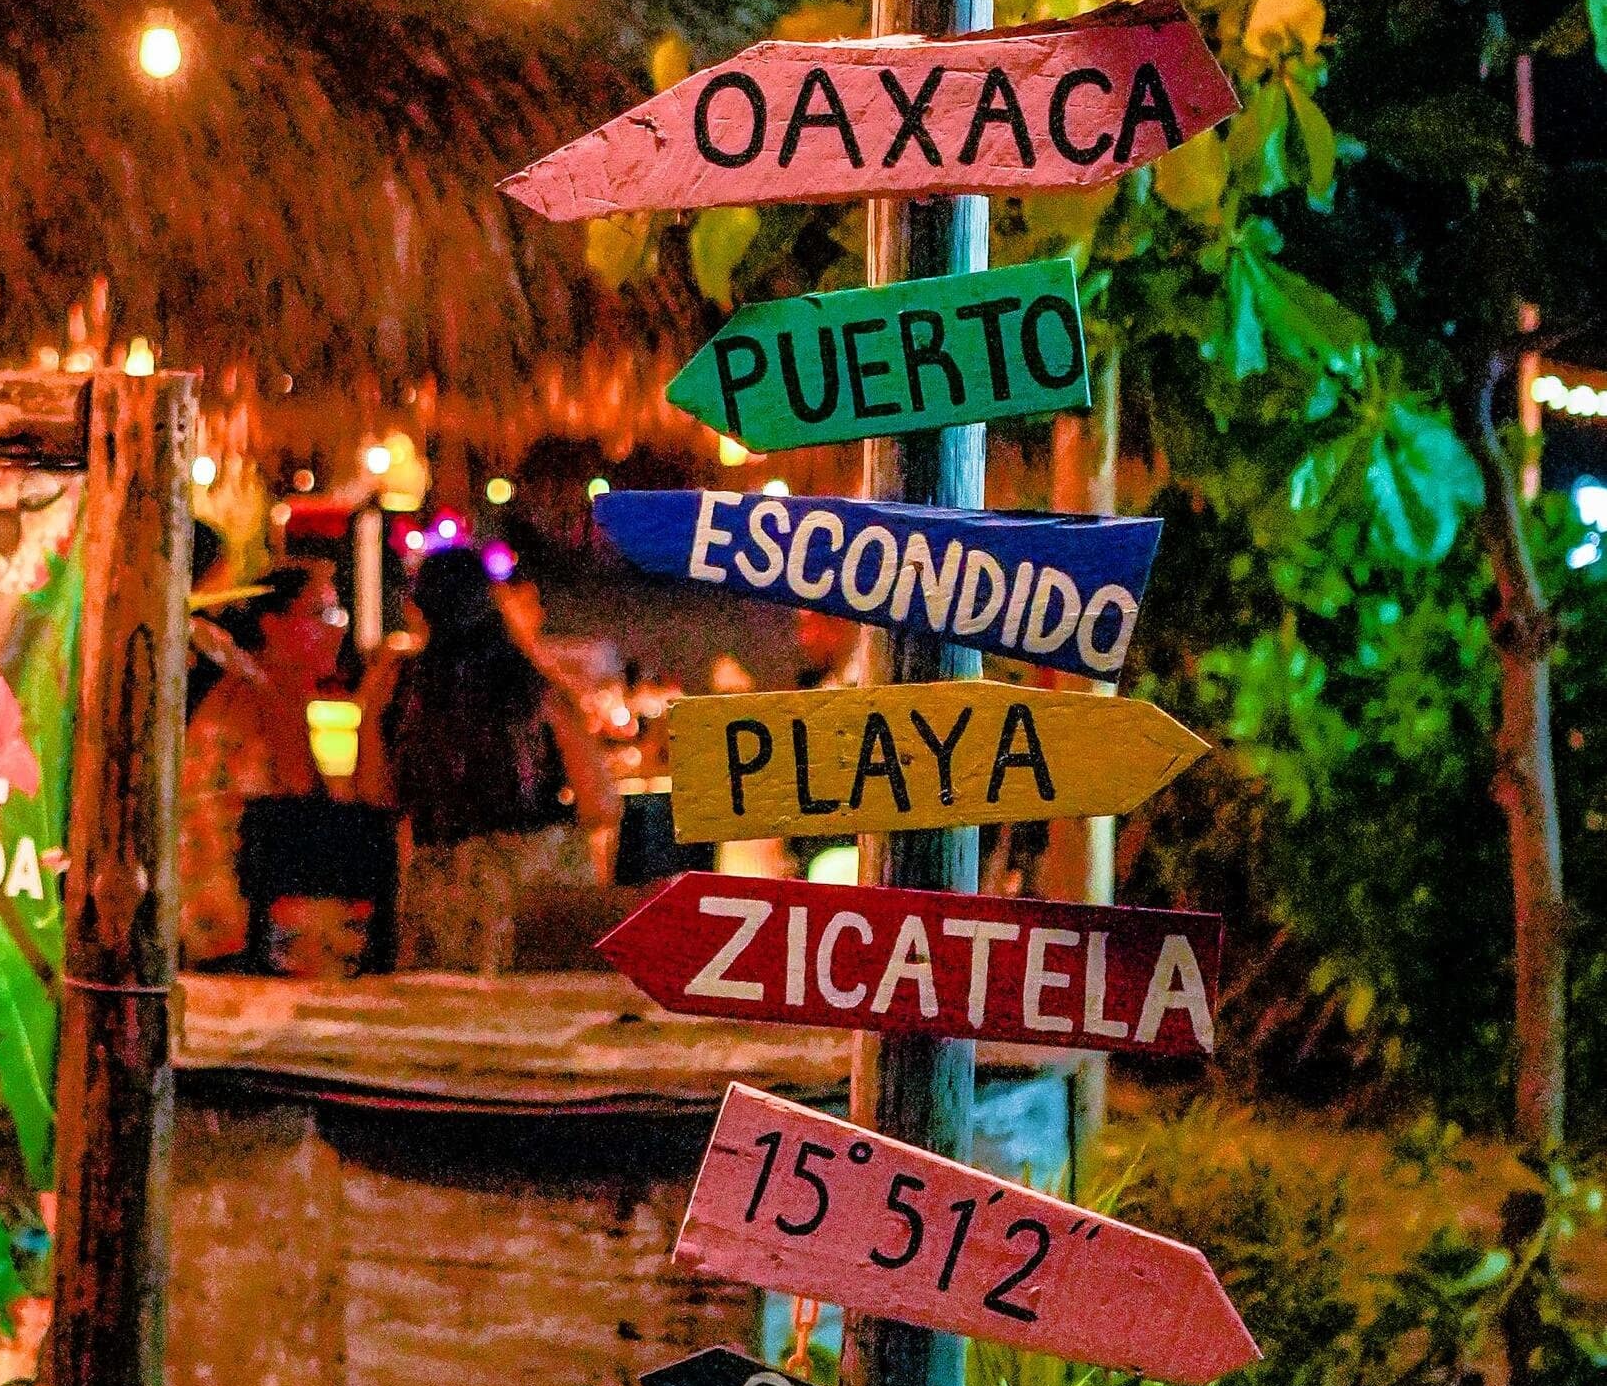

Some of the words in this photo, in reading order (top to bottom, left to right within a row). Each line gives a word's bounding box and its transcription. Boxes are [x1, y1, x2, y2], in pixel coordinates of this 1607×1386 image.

[692, 61, 1183, 169] OAXACA
[712, 293, 1084, 435] PUERTO
[688, 490, 1141, 672] ESCONDIDO
[725, 703, 1056, 816] PLAYA
[684, 896, 1215, 1054] ZICATELA
